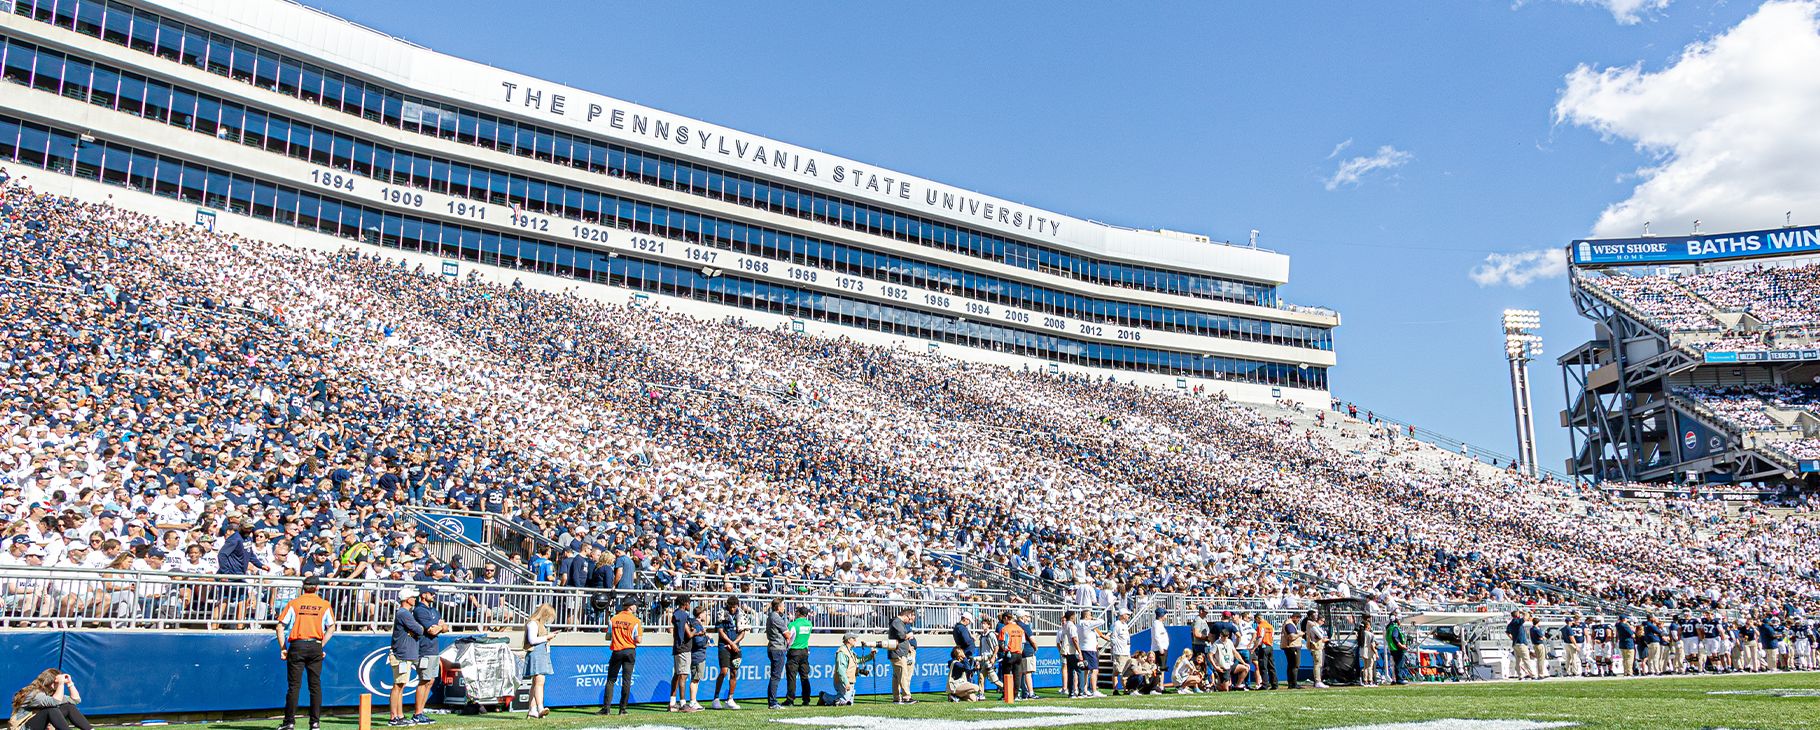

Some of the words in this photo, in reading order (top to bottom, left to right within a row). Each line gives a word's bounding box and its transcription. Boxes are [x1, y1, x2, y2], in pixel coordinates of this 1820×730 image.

[502, 81, 566, 115] THE
[587, 103, 818, 177] PENNSYLVANIA
[832, 165, 911, 200] STATE
[926, 188, 1061, 237] UNIVERSITY
[1686, 235, 1762, 256] BATHS
[1769, 229, 1820, 249] WIN
[1592, 244, 1625, 255] WEST
[1626, 243, 1667, 254] SHORE
[311, 169, 354, 192] 1894
[381, 187, 423, 207] 1909
[447, 200, 485, 220] 1911
[510, 212, 549, 231] 1912
[572, 225, 609, 243] 1920
[630, 236, 665, 254] 1921
[684, 247, 718, 264] 1947
[737, 257, 769, 274] 1968
[787, 267, 817, 283] 1969
[835, 276, 864, 292] 1973
[880, 285, 908, 300] 1982
[924, 293, 950, 308] 1986
[965, 301, 991, 316] 1994
[1005, 309, 1029, 324] 2005
[1043, 316, 1066, 331] 2008
[1080, 324, 1103, 337] 2012
[1117, 329, 1141, 342] 2016
[489, 492, 504, 504] 26
[1594, 628, 1605, 637] 79
[1681, 623, 1694, 633] 70
[1703, 623, 1715, 633] 67
[576, 664, 635, 673] WYND
[875, 663, 890, 677] OF
[921, 663, 949, 677] STATE
[1034, 667, 1061, 675] EWARDS
[576, 677, 635, 687] REWS
